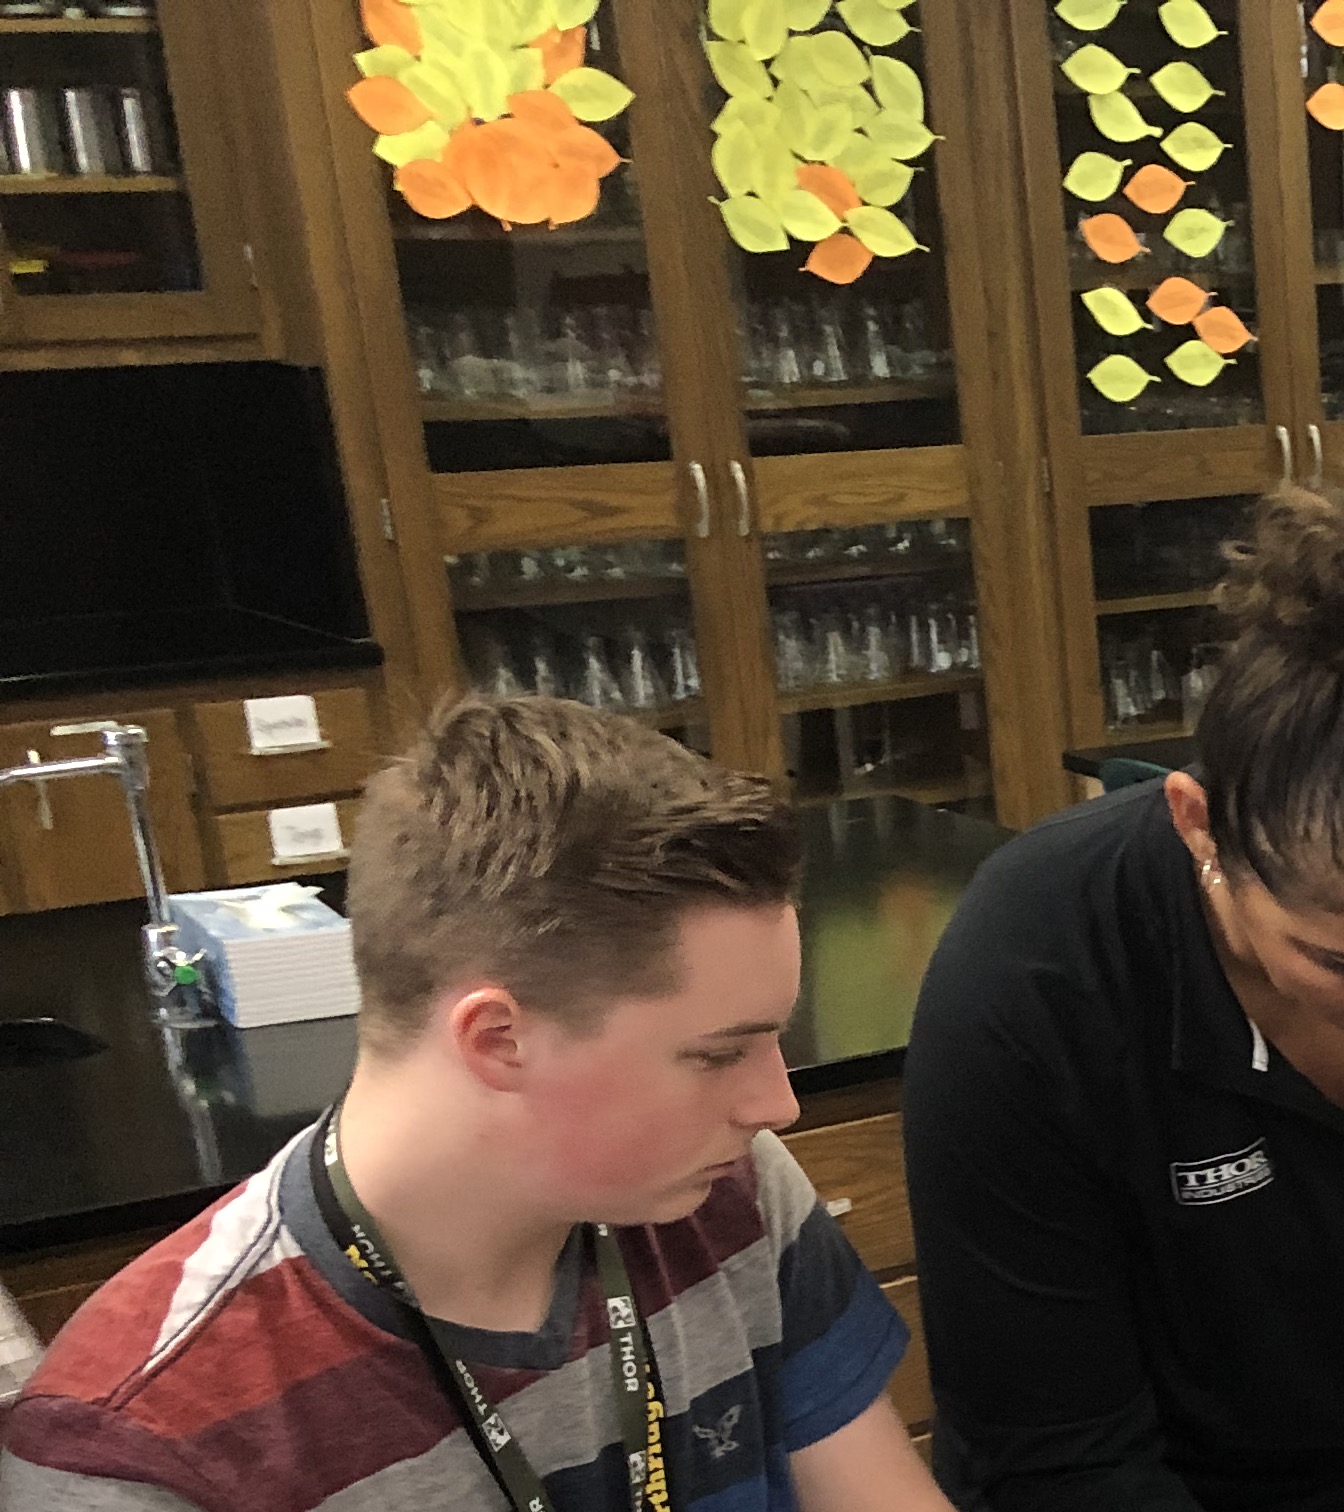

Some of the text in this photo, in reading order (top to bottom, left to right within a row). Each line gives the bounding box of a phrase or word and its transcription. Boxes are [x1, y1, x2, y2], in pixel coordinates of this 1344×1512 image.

[1177, 1150, 1269, 1187] THOR
[455, 1358, 489, 1417] THOR
[618, 1331, 641, 1392] THOR
